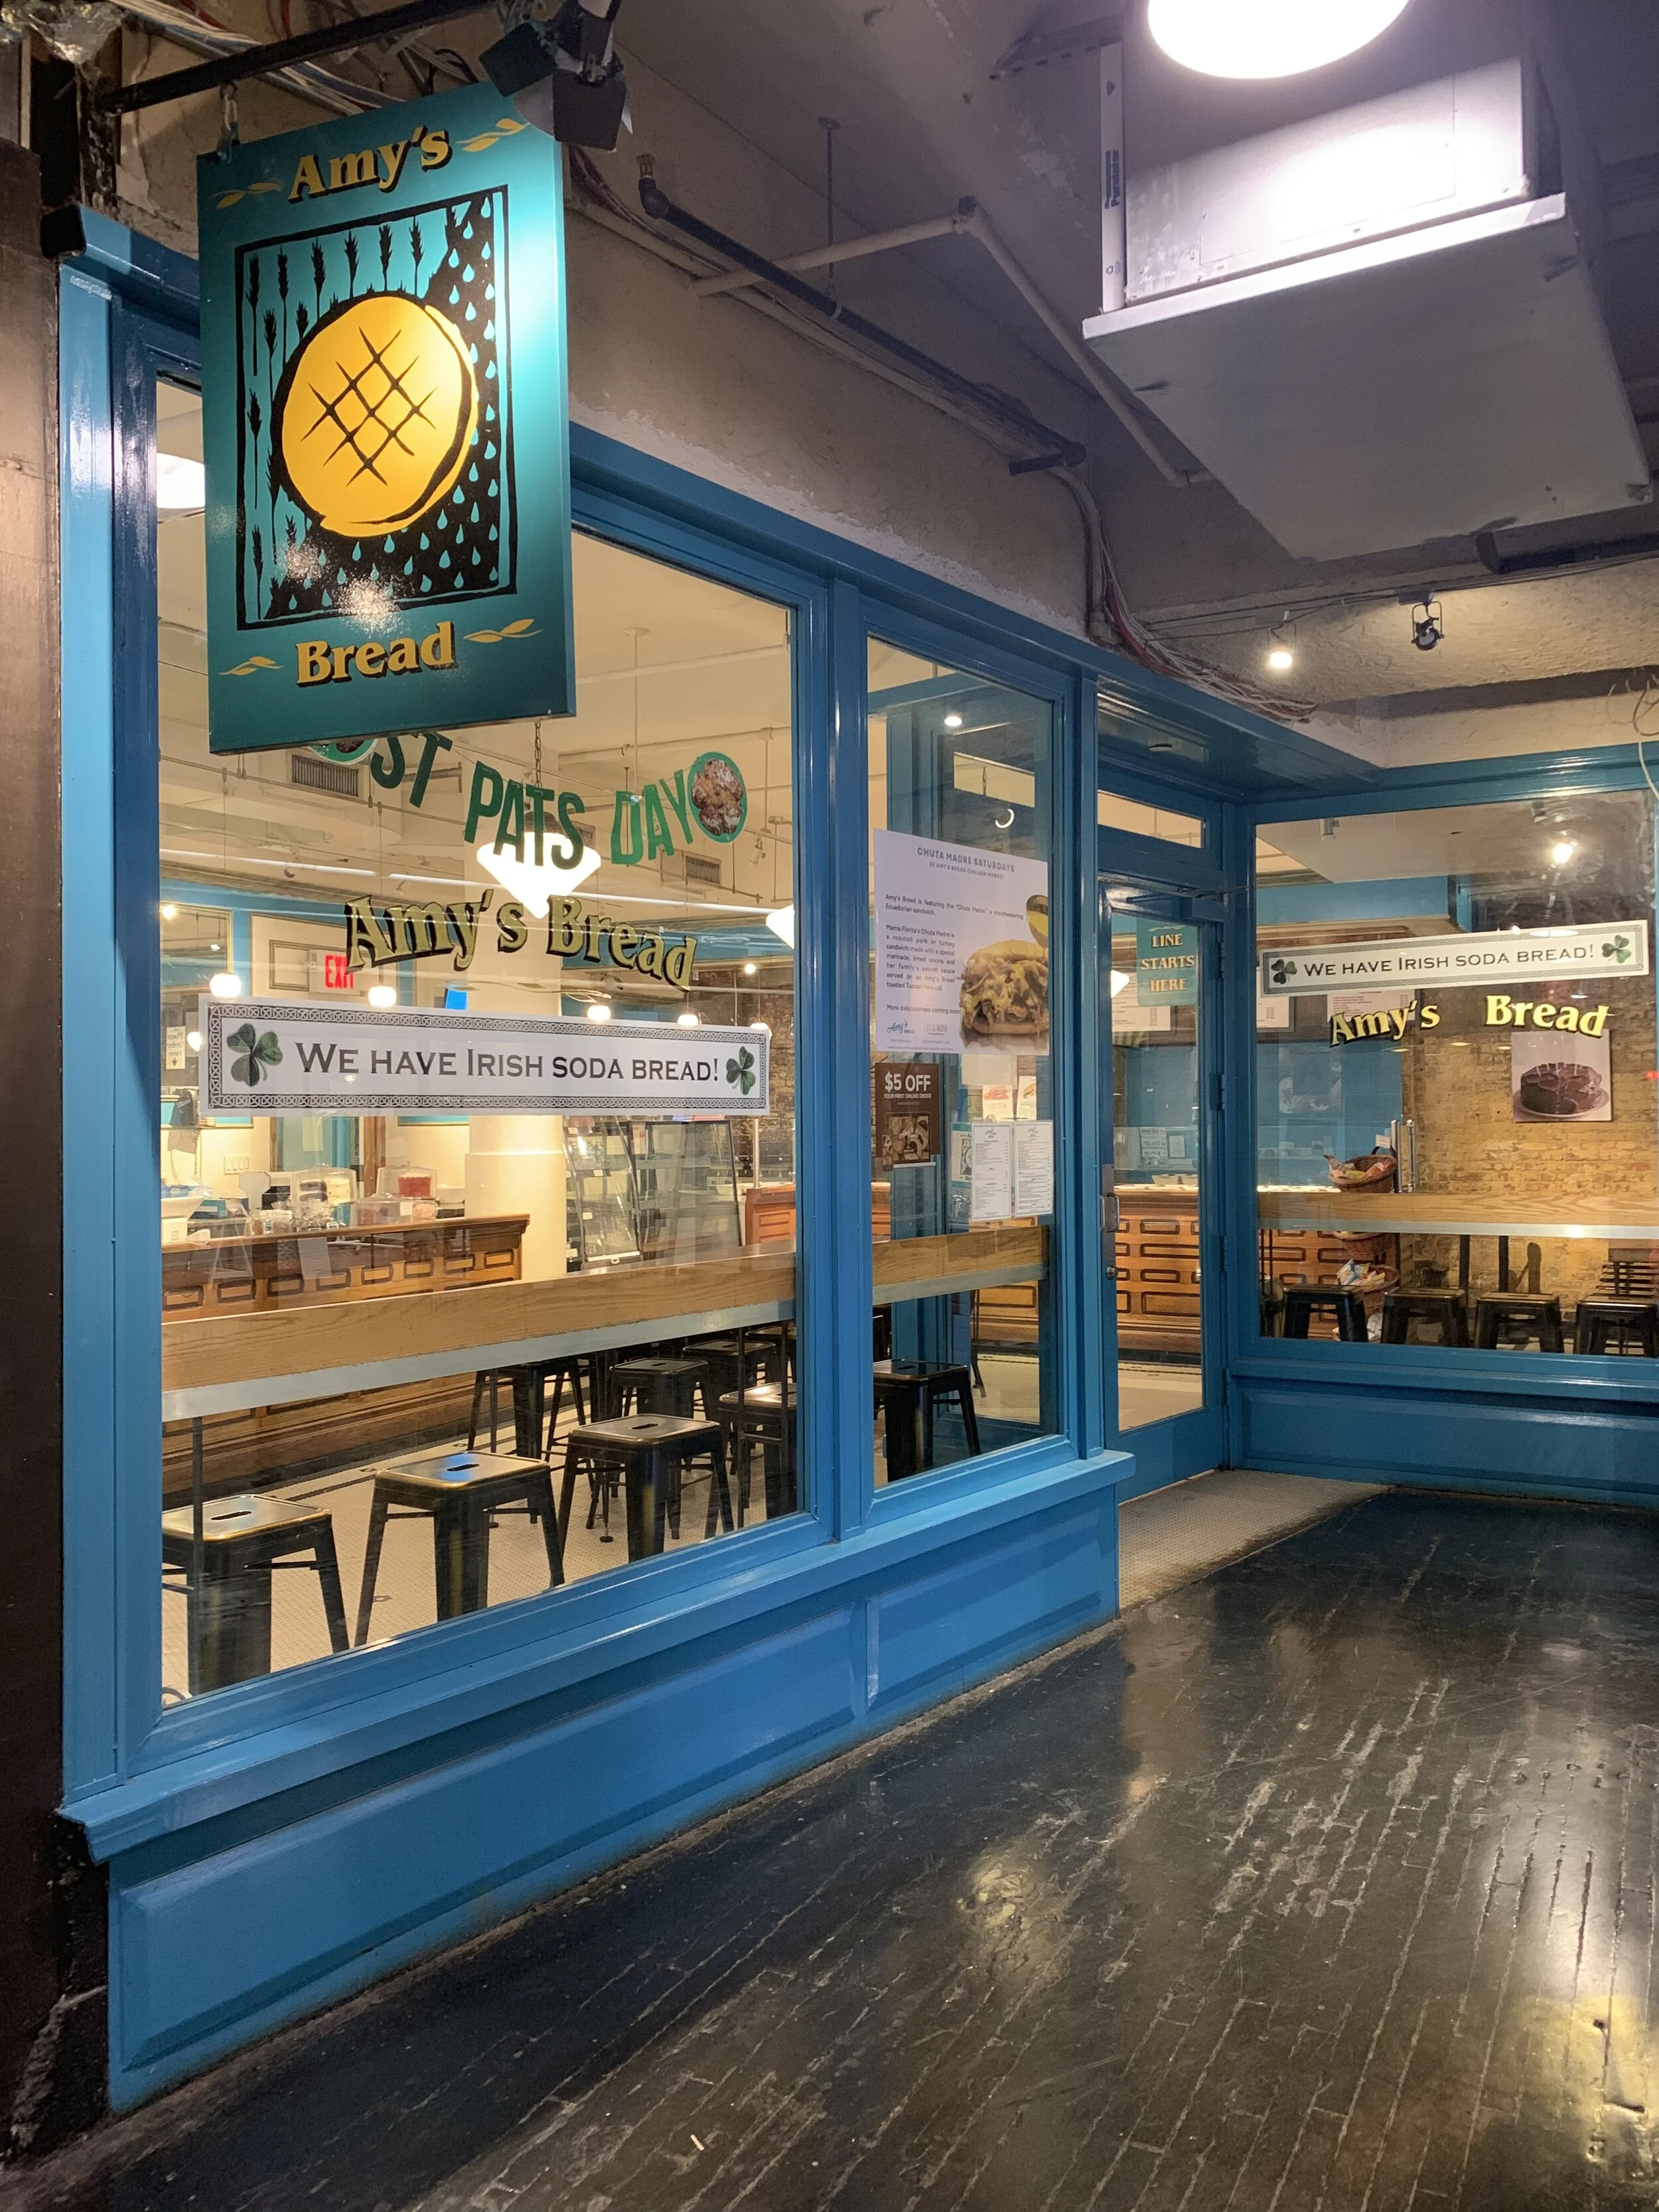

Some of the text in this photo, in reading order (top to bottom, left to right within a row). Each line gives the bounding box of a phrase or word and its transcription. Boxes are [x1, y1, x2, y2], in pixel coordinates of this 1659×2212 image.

[288, 125, 453, 204] Amy's
[295, 621, 458, 686] Bread
[370, 731, 693, 870] ST PATS DAY
[917, 847, 1015, 873] CHUTA MADRE SATURDAYS
[967, 868, 987, 877] CHELSEA
[886, 903, 912, 913] Ecuadorian
[924, 899, 945, 909] featuring
[993, 911, 1024, 921] mouthwatering
[344, 889, 697, 992] Amy's Bread
[1151, 933, 1183, 948] LINE
[898, 962, 919, 971] family's
[1141, 955, 1194, 970] STARTS
[1149, 978, 1187, 992] HERE
[1329, 999, 1441, 1047] Amy's
[1484, 994, 1610, 1039] Bread
[885, 1071, 931, 1092] $5 OFF
